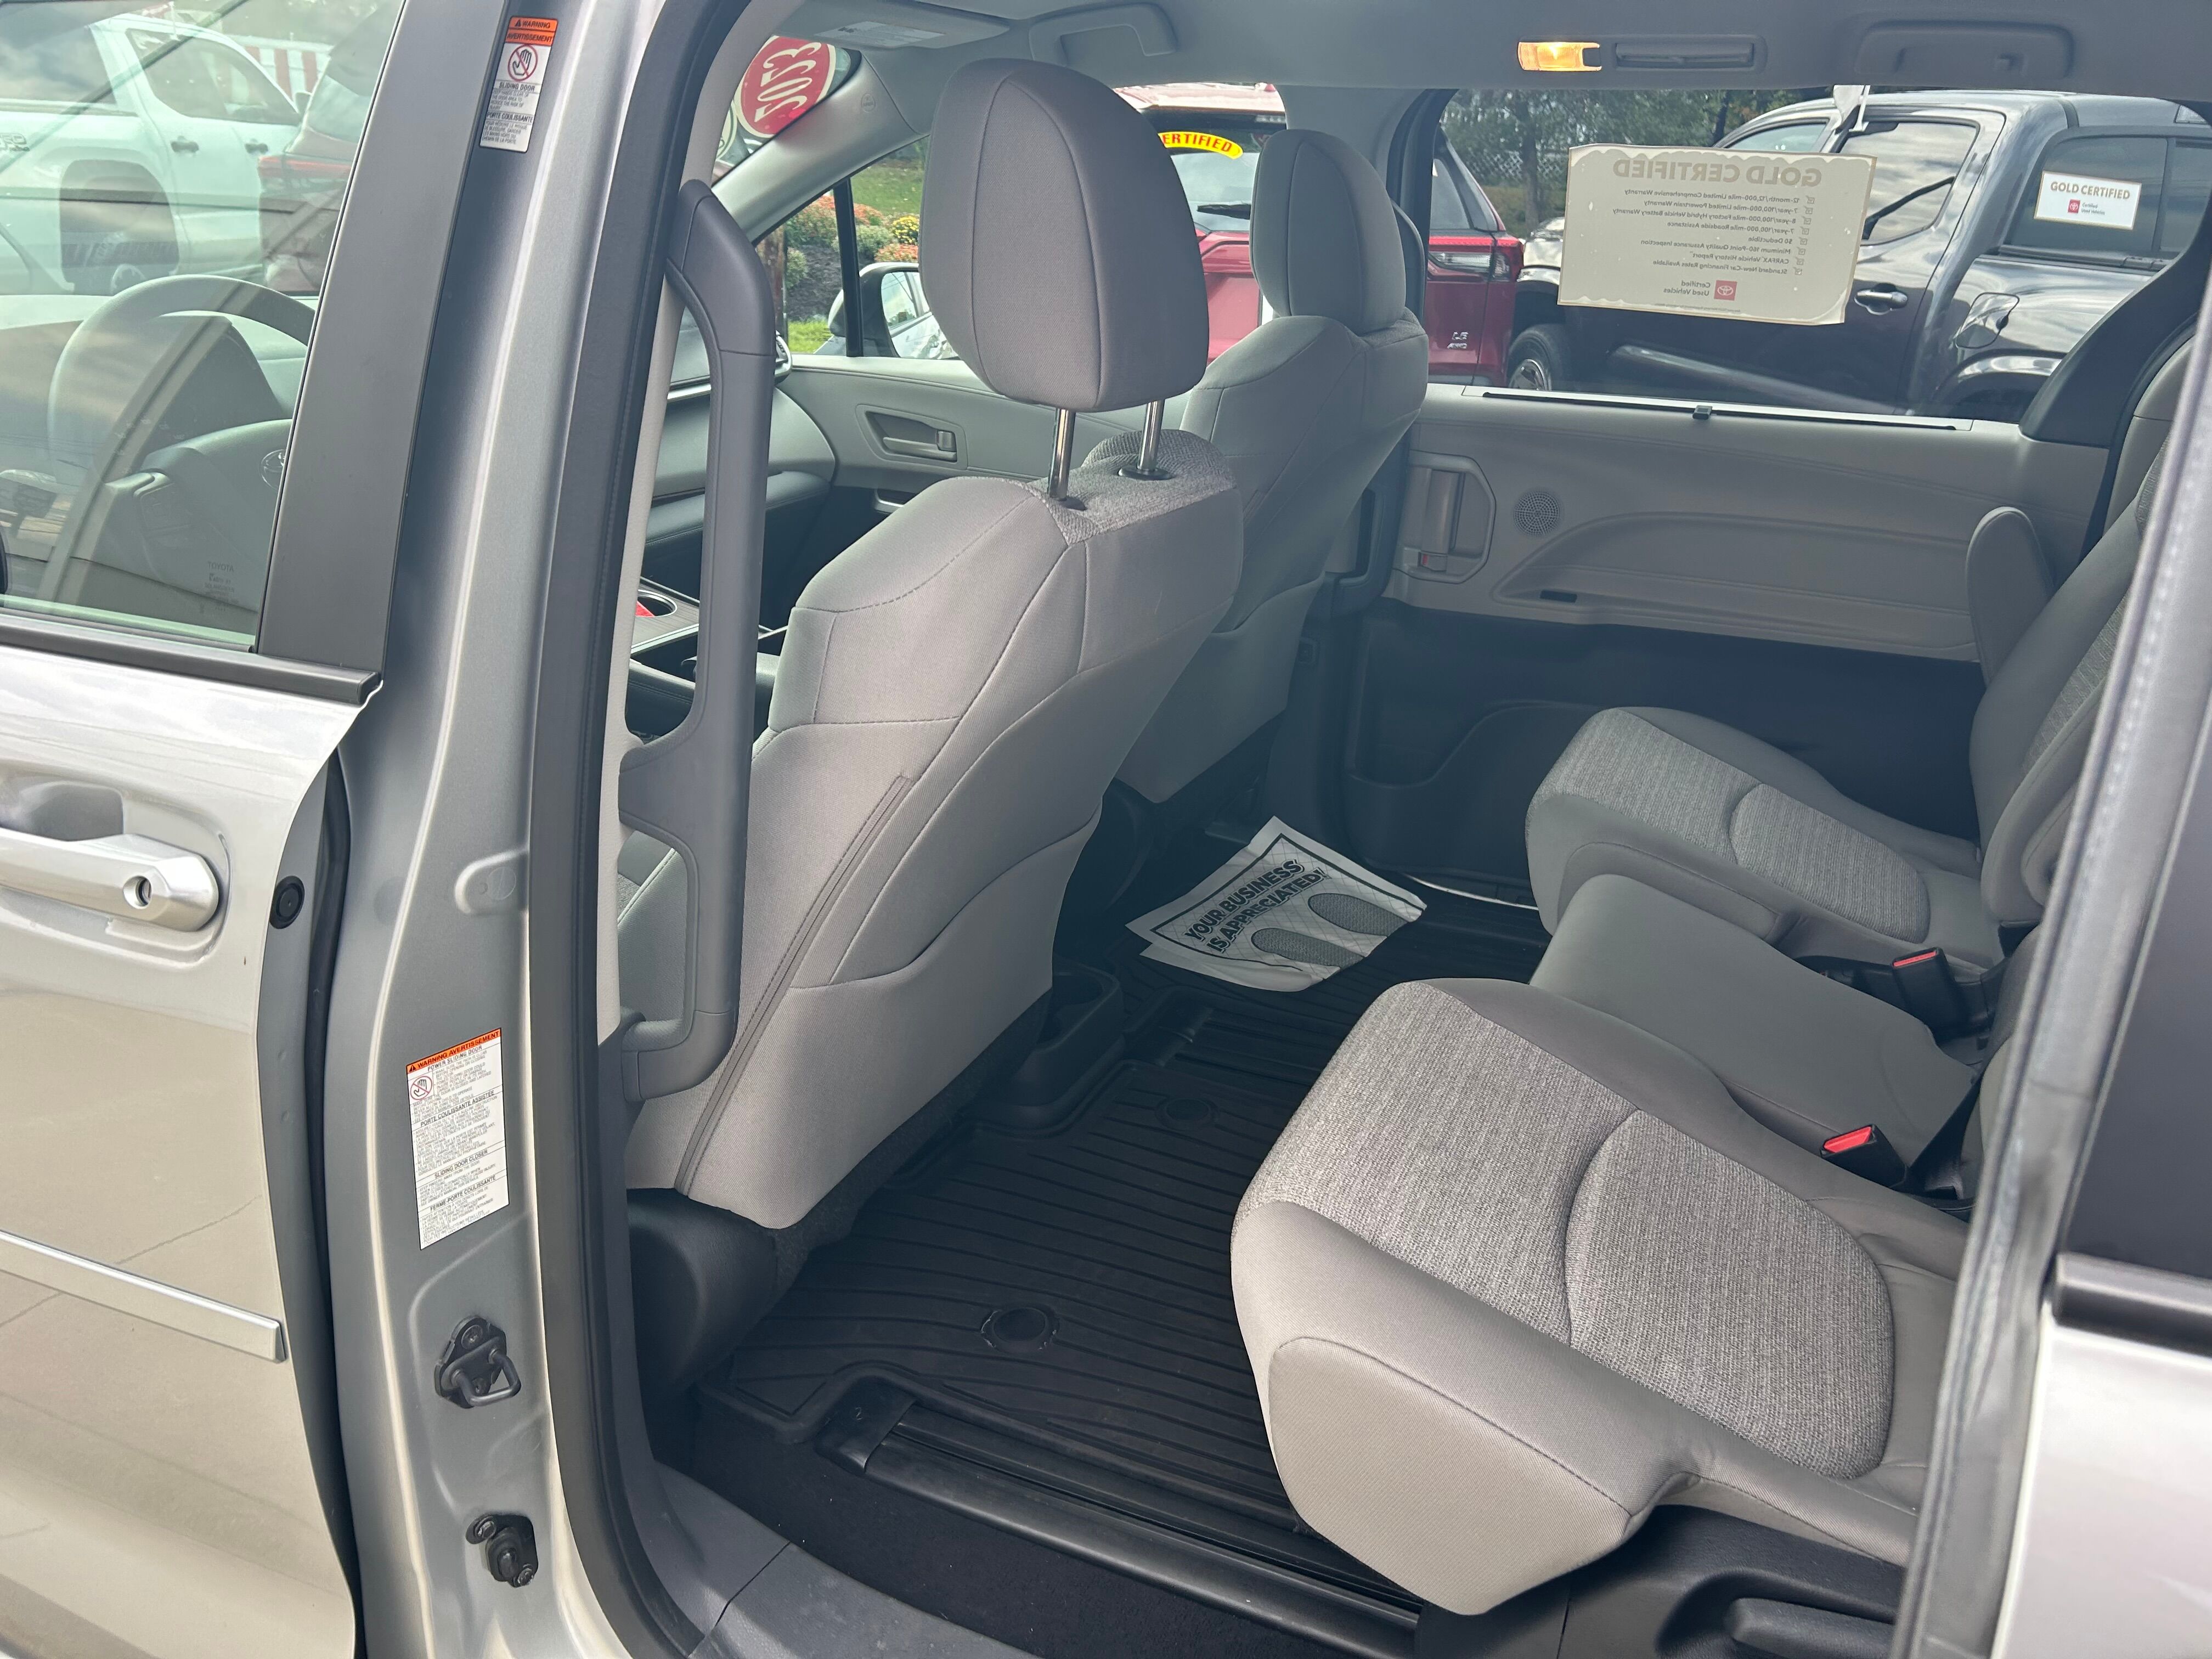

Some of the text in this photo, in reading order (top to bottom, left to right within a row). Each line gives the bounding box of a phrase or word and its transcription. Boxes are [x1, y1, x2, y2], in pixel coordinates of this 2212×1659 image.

[522, 20, 551, 29] WARNING
[507, 32, 553, 42] AVERTISSEMENT
[1161, 133, 1232, 152] ERTIFIED
[2050, 181, 2130, 200] GOLD CERTIFIED
[208, 561, 234, 572] TOYOTA
[1184, 859, 1305, 941] YOUR BUSINESS
[1206, 867, 1327, 953] IS APPRECIATED!
[417, 1031, 498, 1068] WARNING AVERTISSEMENT
[427, 1045, 482, 1071] POWER SLIDING DOOR
[420, 1116, 436, 1127] PORTE
[438, 1101, 470, 1119] COULISSANTE
[435, 1149, 487, 1178] SLIDING DOOR CLOSER
[464, 1175, 495, 1194] COULISSANTE
